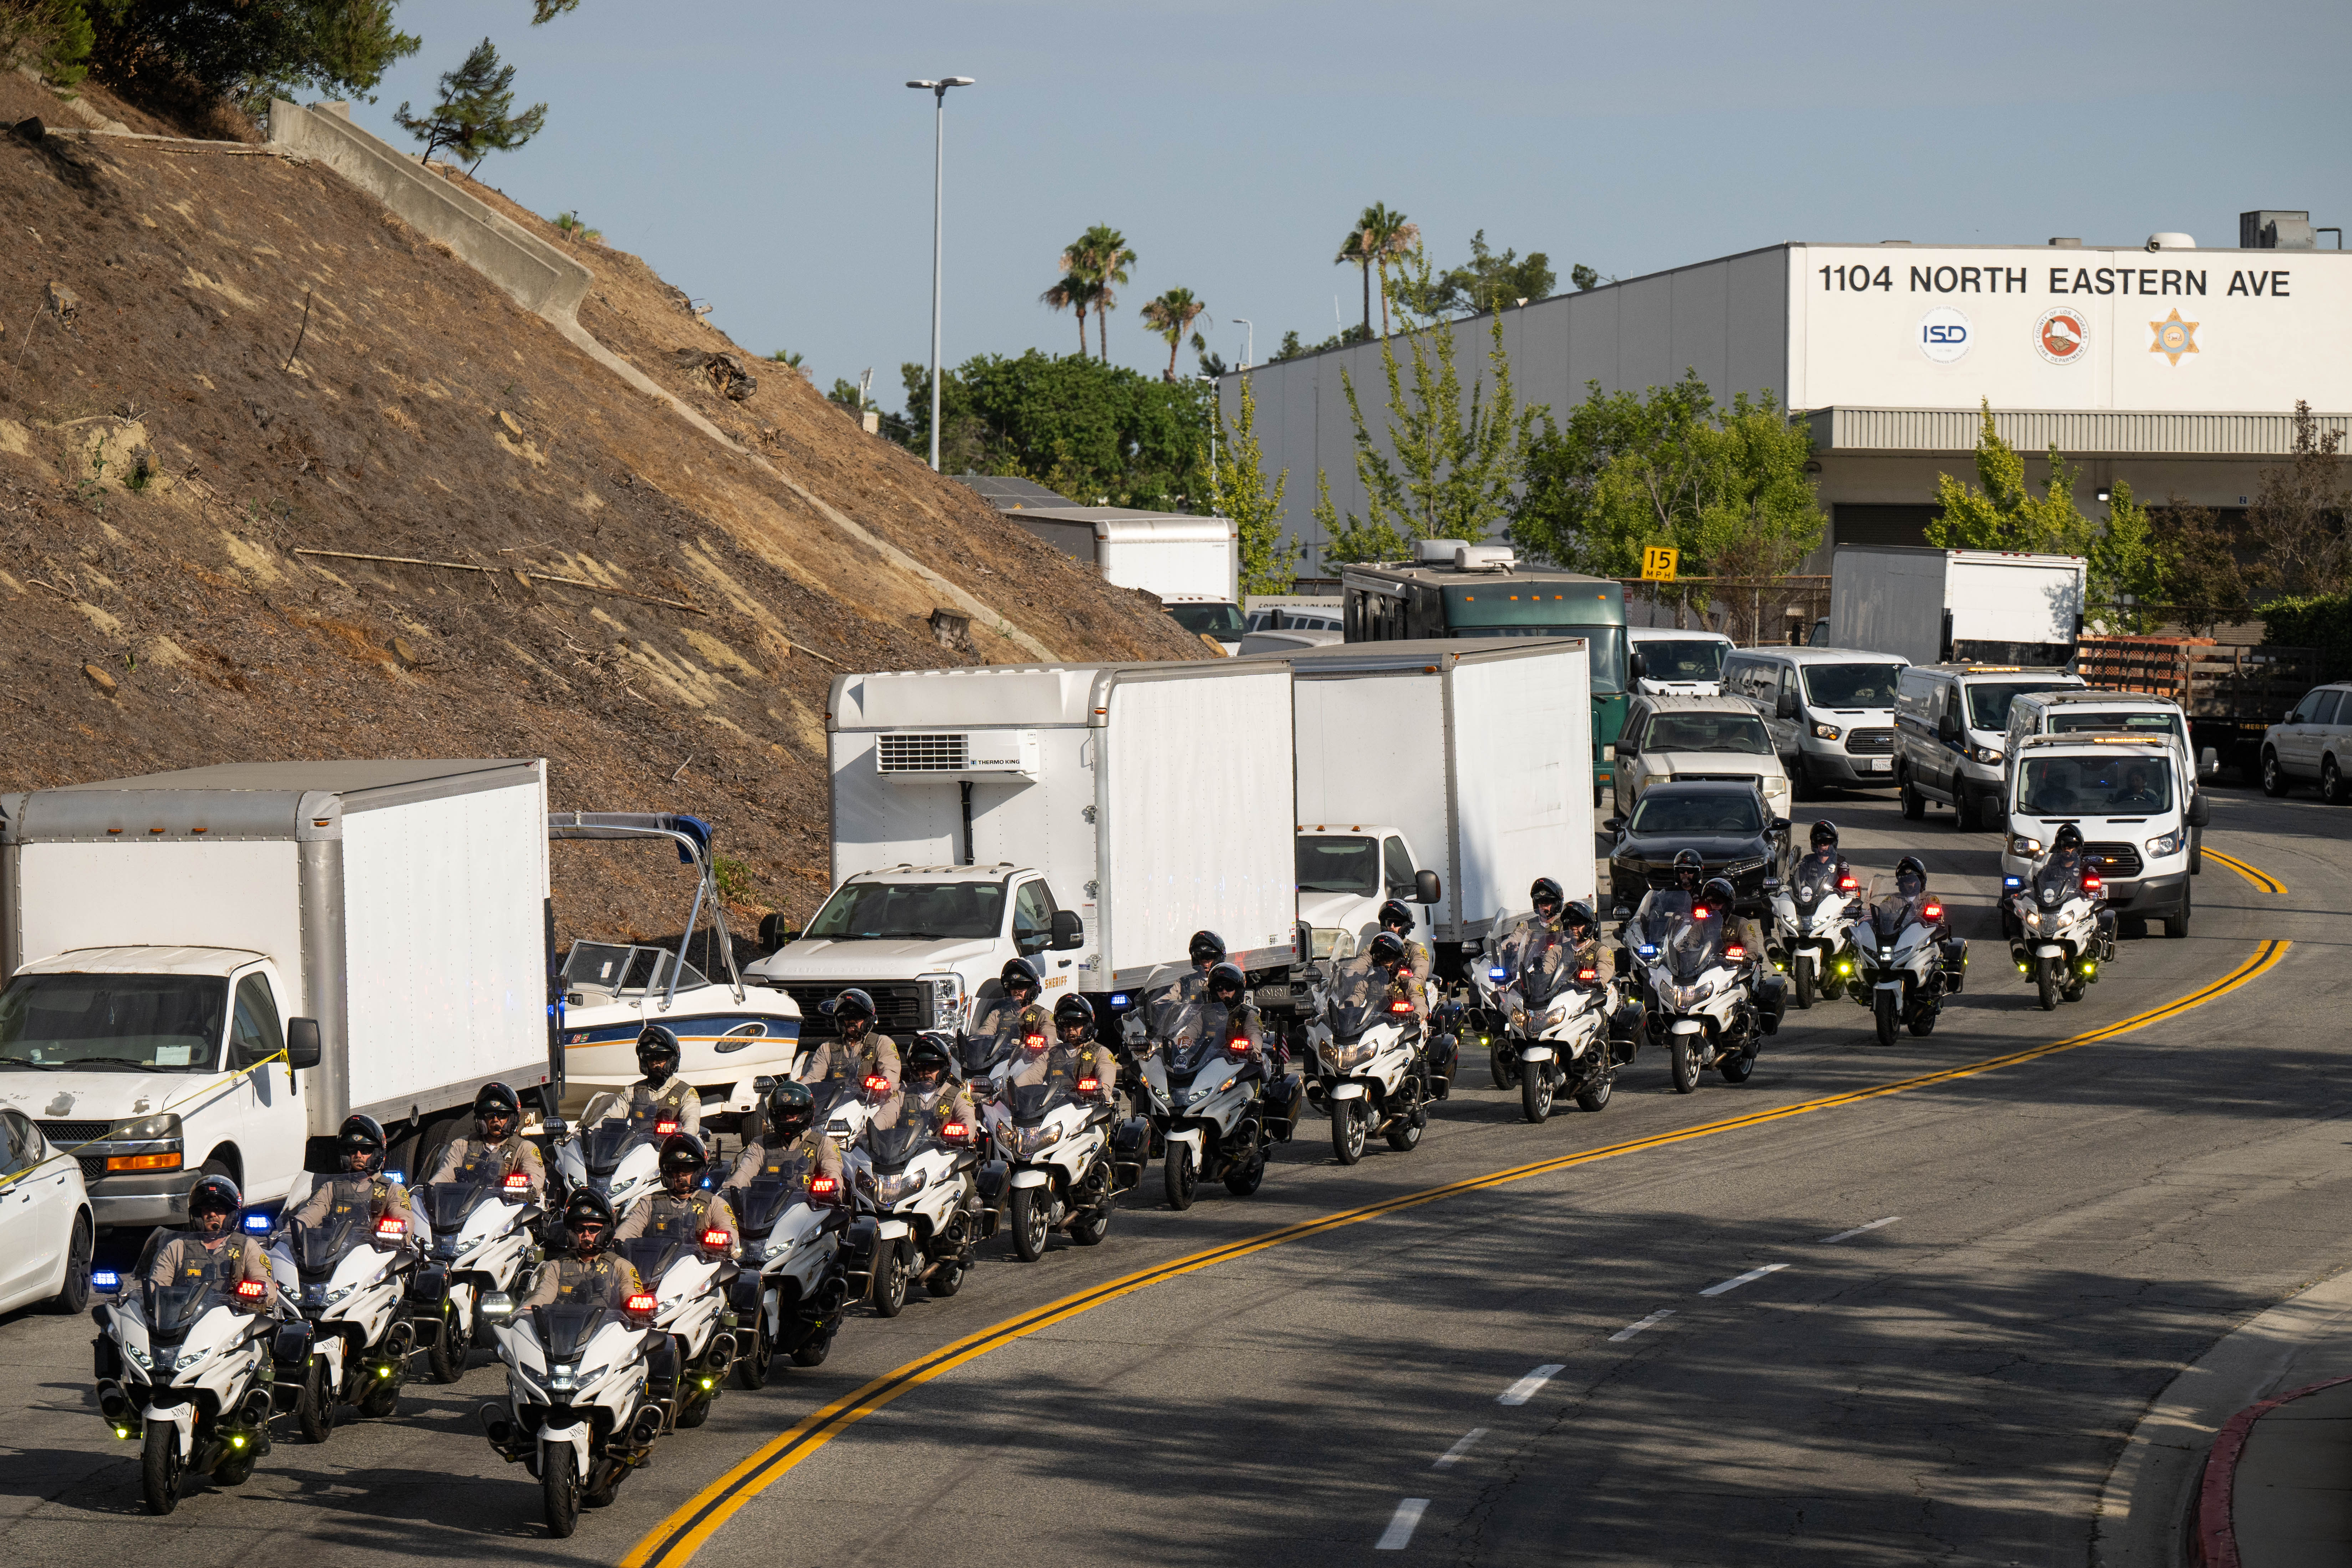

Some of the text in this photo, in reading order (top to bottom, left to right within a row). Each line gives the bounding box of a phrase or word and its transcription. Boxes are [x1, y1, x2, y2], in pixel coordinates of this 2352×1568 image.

[1819, 265, 2290, 296] 1104 NORTH EASTERN AVE
[2036, 316, 2047, 338] COUNTY
[2073, 314, 2087, 339] ANGELES
[1924, 325, 1966, 343] ISD
[2038, 345, 2084, 362] FIRE DEPARTMENT
[1650, 550, 1670, 569] 15
[1646, 570, 1671, 579] MPH
[1833, 918, 1846, 929] POLIC
[2077, 918, 2089, 930] POLIC
[1631, 929, 1641, 944] POLICE
[1045, 975, 1067, 989] SHERIFF
[322, 1340, 337, 1351] A7M3
[171, 1407, 189, 1419] A7M1
